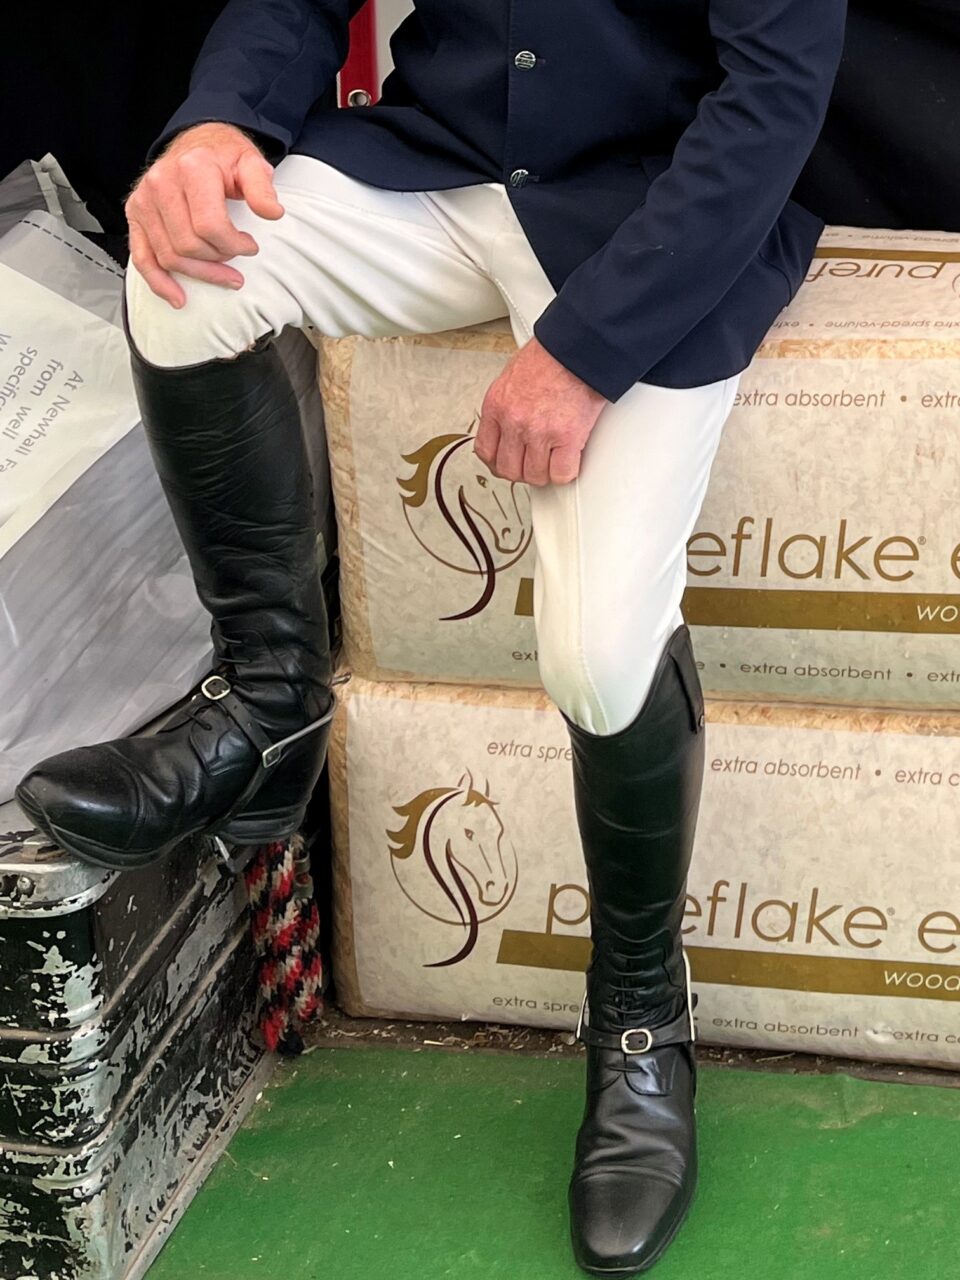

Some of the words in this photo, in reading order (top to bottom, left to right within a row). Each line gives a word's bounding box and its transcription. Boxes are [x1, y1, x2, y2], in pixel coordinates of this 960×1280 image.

[804, 261, 948, 282] puref
[30, 358, 64, 397] from
[64, 370, 84, 391] At
[733, 390, 779, 407] extra
[784, 389, 886, 407] absorbent
[2, 405, 32, 440] well
[15, 395, 71, 456] Newhall
[686, 516, 927, 582] eflake®
[739, 662, 788, 676] extra
[793, 664, 892, 681] absorbent
[487, 740, 533, 757] extra
[710, 757, 758, 775] extra
[764, 760, 862, 781] absorbent
[895, 767, 943, 786] extra
[492, 995, 537, 1010] extra
[712, 1016, 758, 1031] extra
[764, 1019, 859, 1038] absorbent
[892, 1028, 939, 1044] extra
